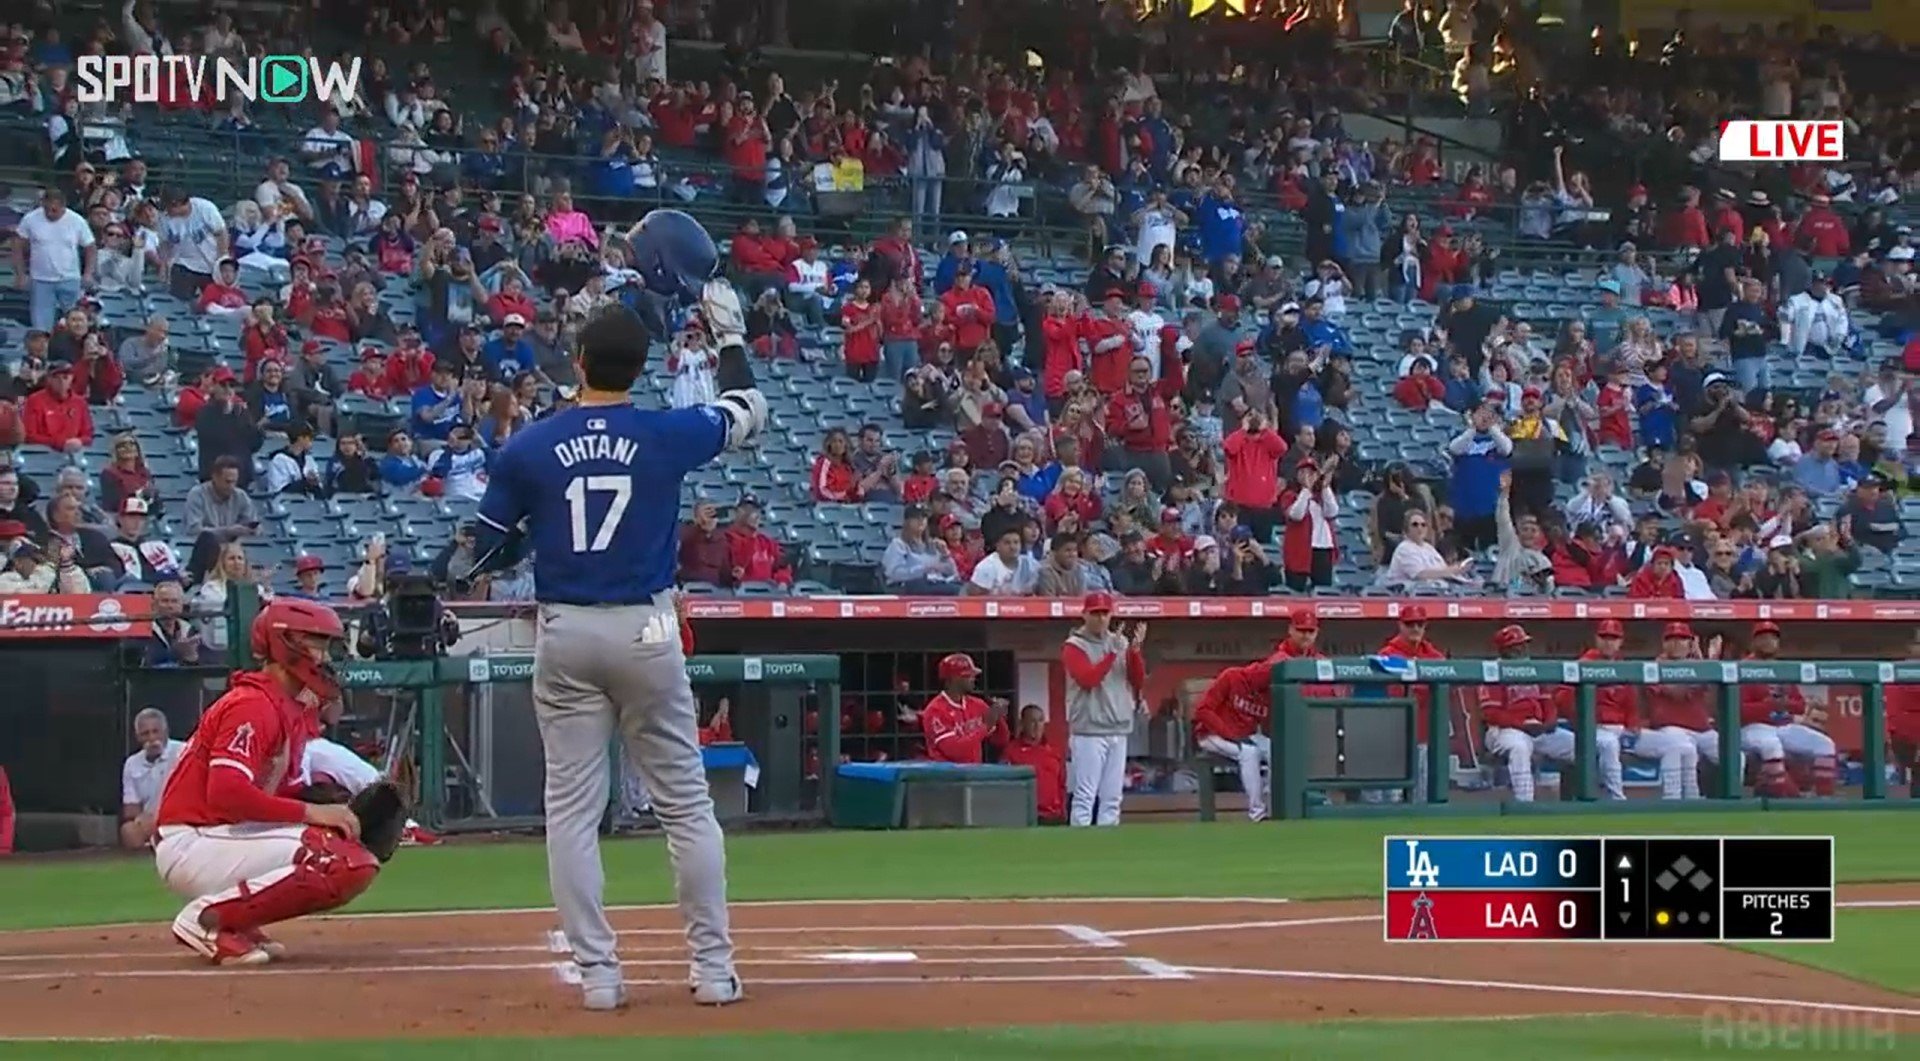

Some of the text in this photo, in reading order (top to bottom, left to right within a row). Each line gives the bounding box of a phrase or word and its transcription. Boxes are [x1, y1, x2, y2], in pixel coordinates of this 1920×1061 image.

[554, 434, 639, 468] OHTANI
[565, 475, 632, 552] 17
[2, 599, 74, 632] Farm
[765, 663, 806, 674] TOYOTA
[1336, 665, 1373, 675] TOYOTA
[1419, 665, 1457, 676] TOYOTA
[1501, 666, 1537, 677] TOYOTA
[1581, 667, 1617, 678] TOYOTA
[1661, 667, 1697, 678] TOYOTA
[1740, 668, 1776, 678] TOYOTA
